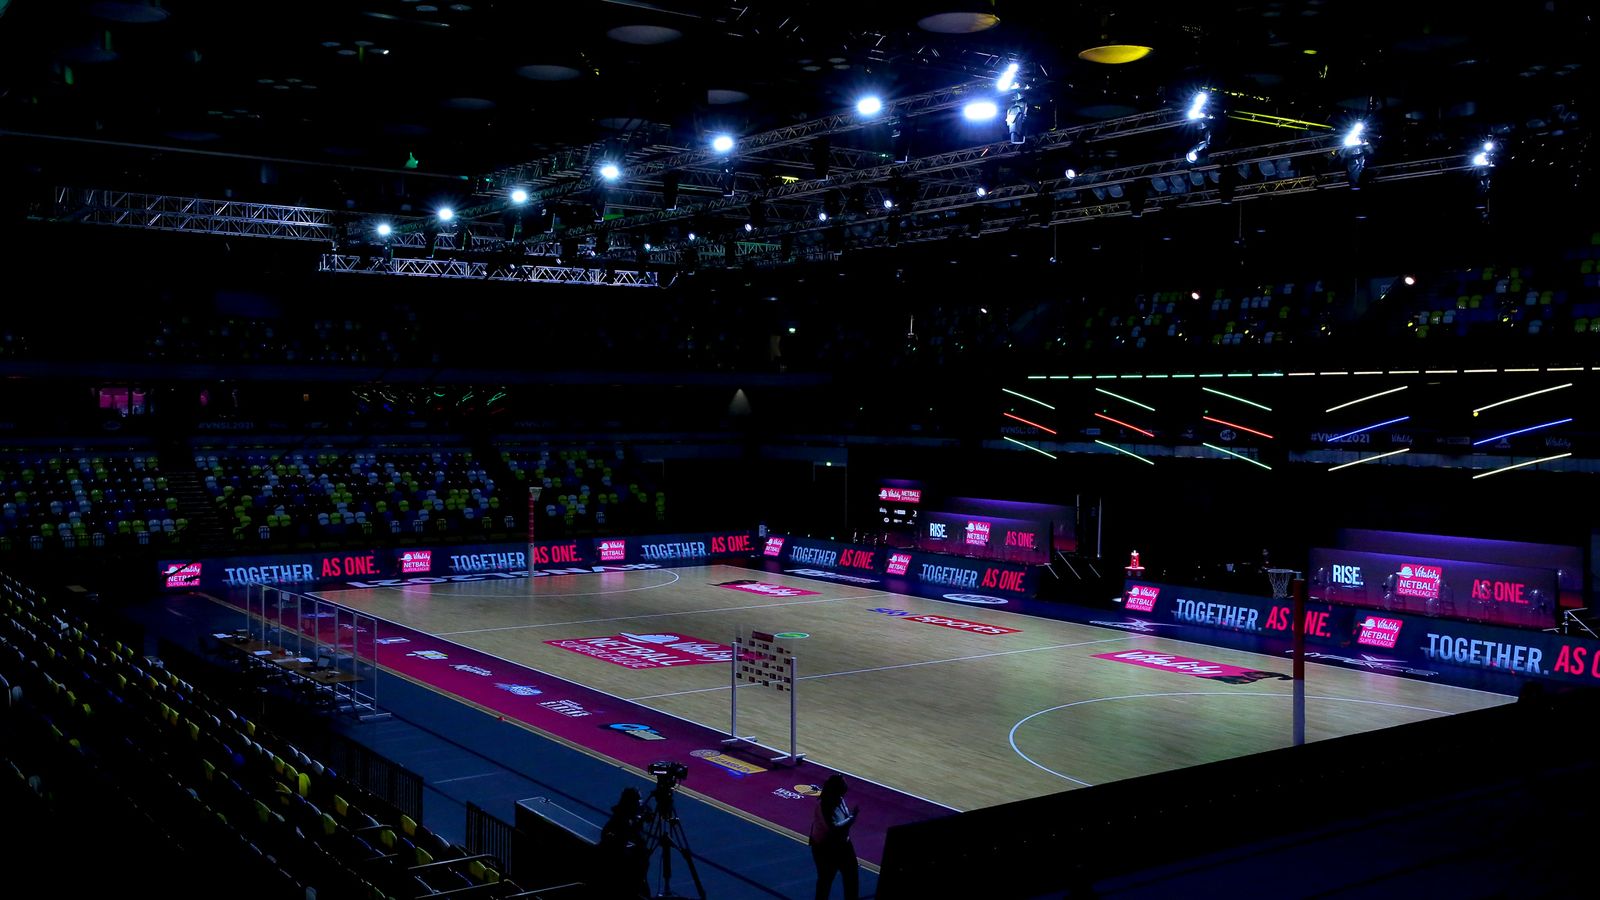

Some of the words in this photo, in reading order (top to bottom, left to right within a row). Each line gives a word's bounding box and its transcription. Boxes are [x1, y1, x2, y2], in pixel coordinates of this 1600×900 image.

[929, 522, 948, 538] RISE.
[1005, 531, 1017, 546] AS
[711, 536, 726, 553] AS
[728, 534, 755, 552] ONE.
[533, 546, 549, 564] AS
[551, 544, 582, 563] ONE.
[839, 548, 854, 567] AS
[854, 550, 875, 570] ONE.
[322, 557, 341, 577] AS
[344, 555, 380, 575] ONE.
[403, 561, 430, 569] NETBALL
[1414, 565, 1440, 583] Vitality
[981, 567, 998, 588] AS
[999, 570, 1026, 592] ONE.
[1332, 564, 1364, 586] RISE.
[1140, 586, 1157, 599] Vitality
[1399, 579, 1437, 591] NETBALL
[1471, 579, 1491, 600] AS
[1494, 581, 1529, 604] ONE.
[1128, 596, 1154, 607] NETBALL
[1265, 606, 1290, 631] AS
[1292, 610, 1331, 638] NE.
[1376, 618, 1400, 634] Vitality
[1360, 630, 1396, 642] NETBALL
[578, 637, 692, 666] NETBALL
[1554, 645, 1587, 675] AS
[1113, 651, 1222, 674] Vitality
